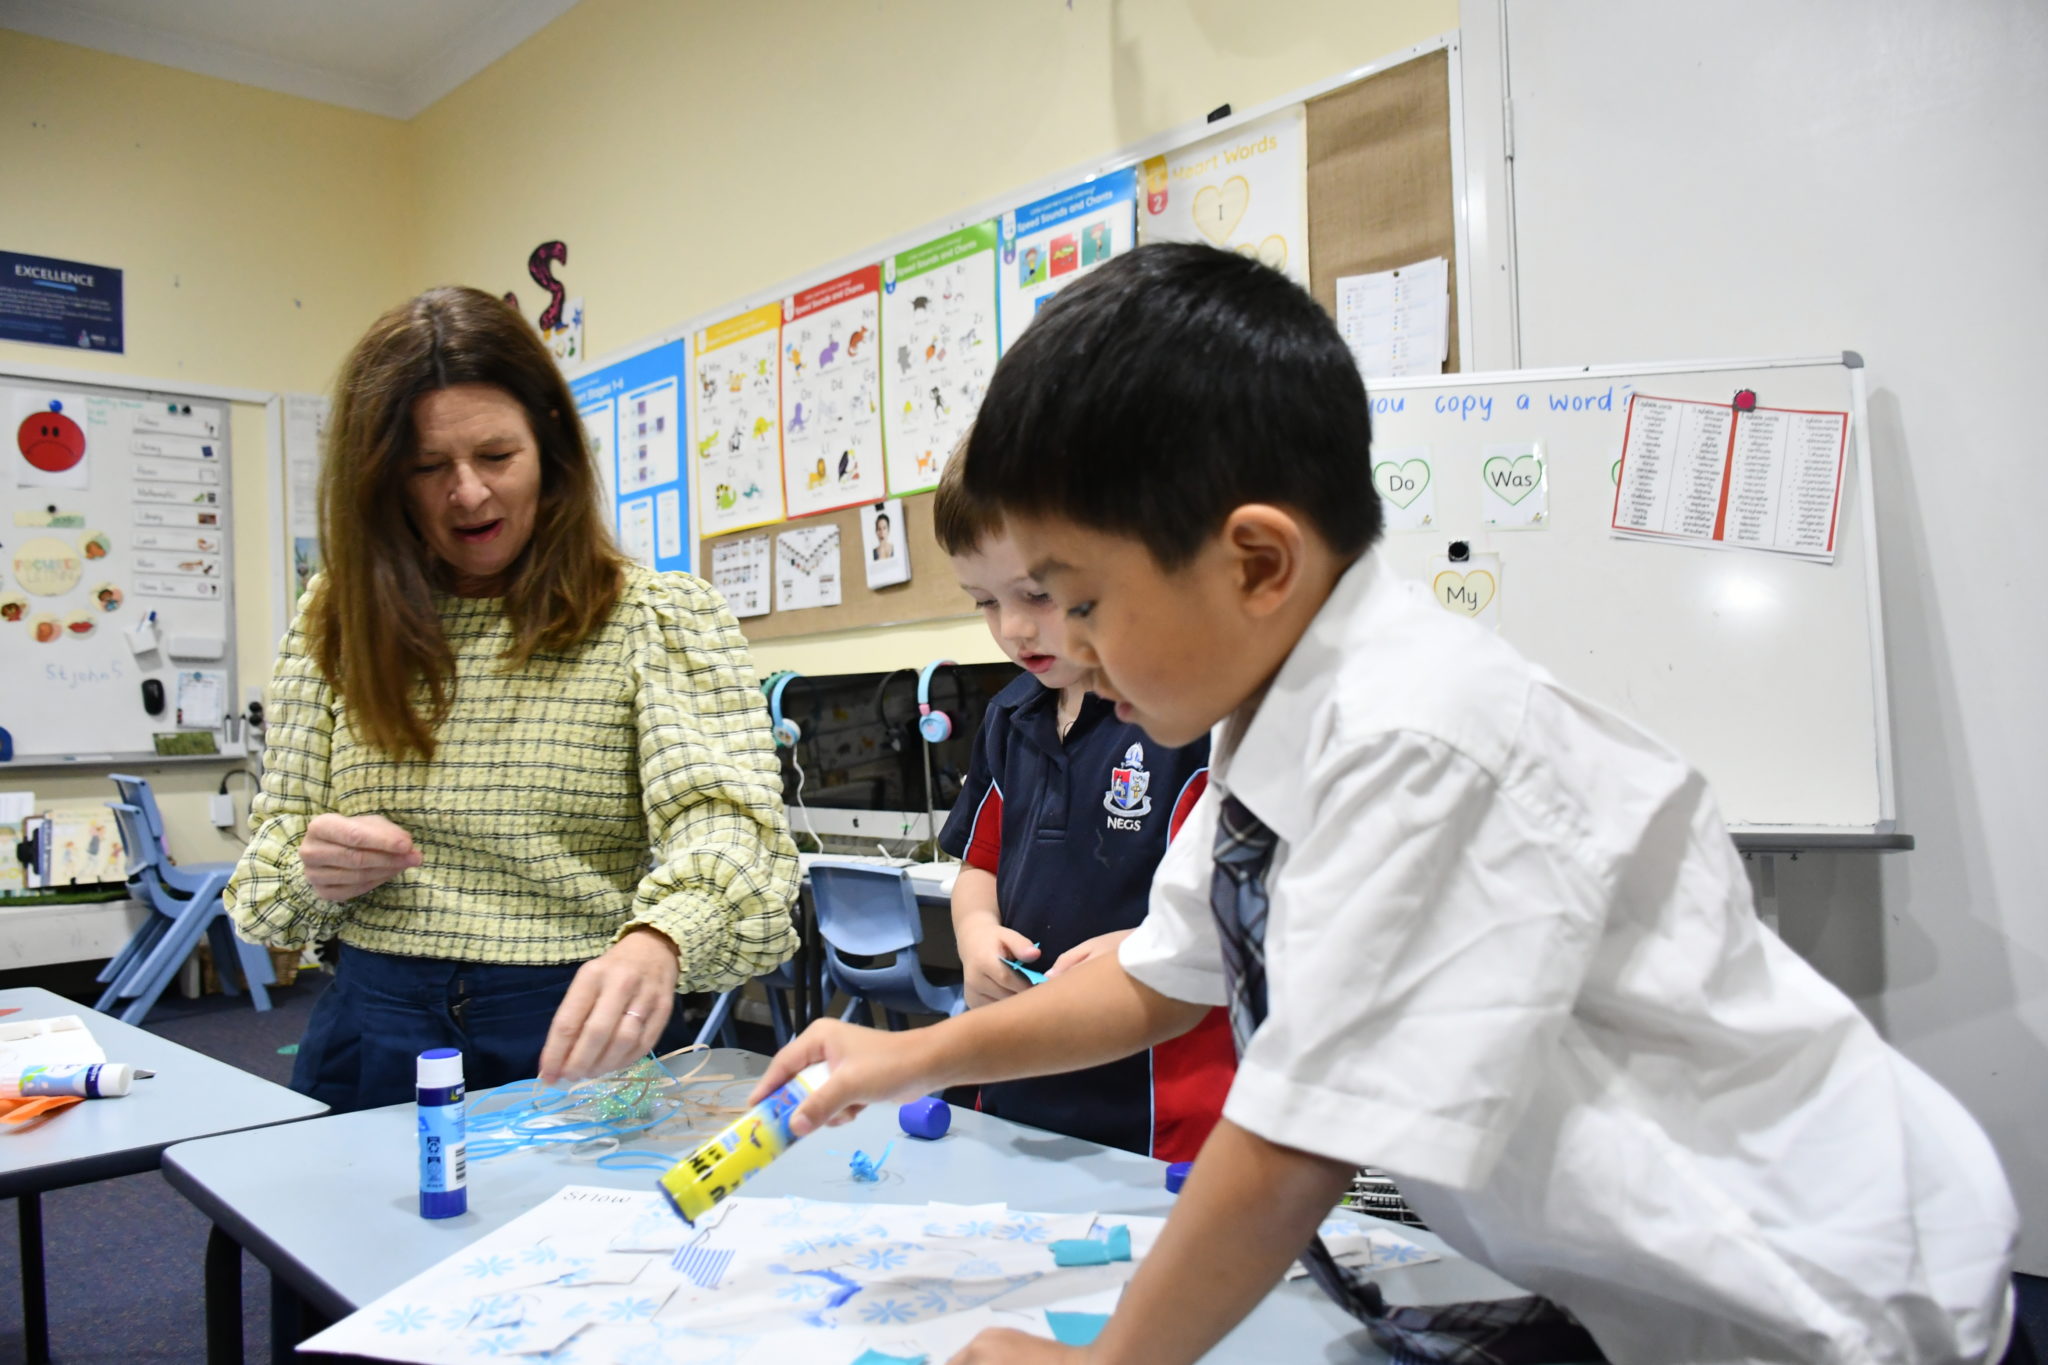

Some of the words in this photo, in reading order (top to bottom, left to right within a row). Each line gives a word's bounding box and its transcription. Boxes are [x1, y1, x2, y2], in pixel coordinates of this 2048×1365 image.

[1172, 155, 1218, 179] Heart
[1223, 135, 1277, 164] Words
[1041, 207, 1068, 224] Sounds
[1069, 199, 1084, 213] and
[1085, 190, 1113, 207] Chants
[1153, 196, 1162, 212] 2
[15, 264, 95, 288] EXCELLENCE
[1435, 393, 1493, 421] copy
[1516, 394, 1530, 410] a
[1389, 475, 1415, 492] Do
[1491, 471, 1532, 487] Was
[1447, 586, 1478, 611] My
[1107, 816, 1141, 831] NEGS
